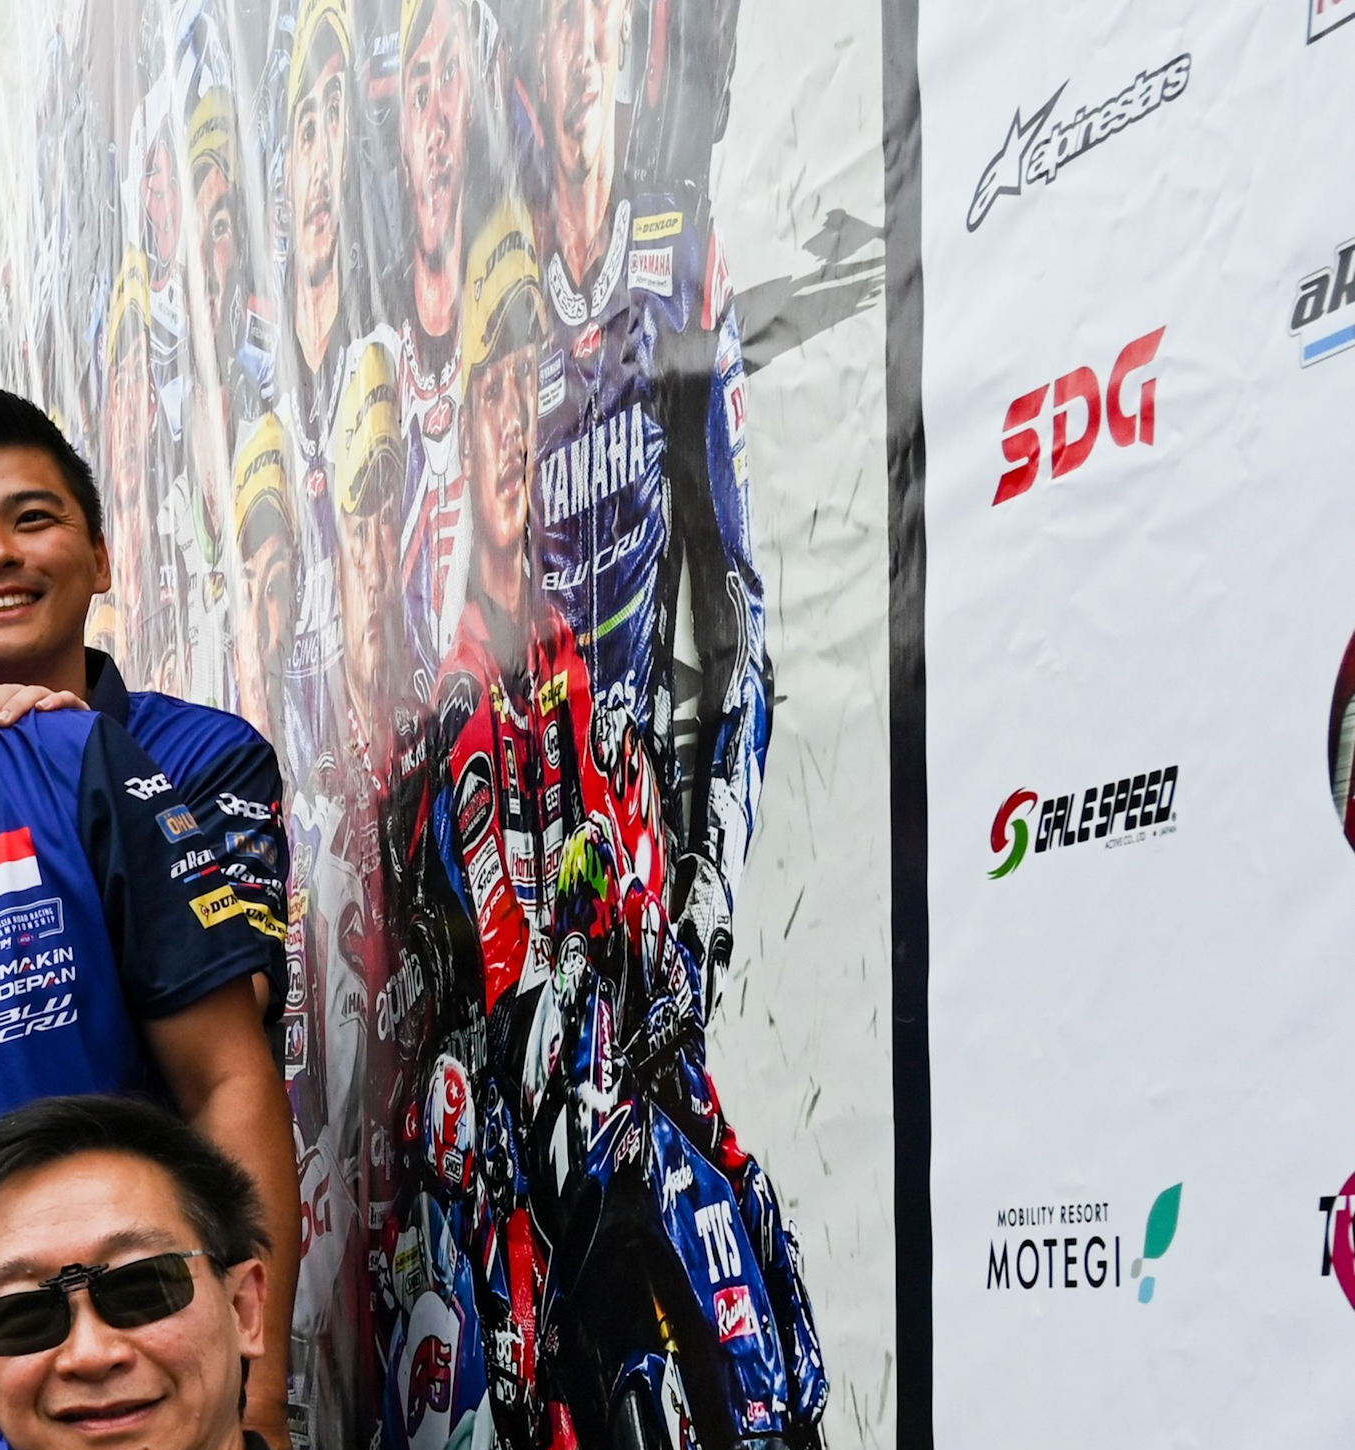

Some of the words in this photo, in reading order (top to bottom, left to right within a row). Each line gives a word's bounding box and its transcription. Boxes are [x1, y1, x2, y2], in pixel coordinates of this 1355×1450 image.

[639, 253, 671, 277] YAMAHA
[992, 325, 1166, 506] SDG
[541, 402, 646, 527] YAMAHA
[541, 561, 589, 590] BLU
[998, 1206, 1055, 1227] MOBILITY
[1060, 1203, 1109, 1224] RESORT
[694, 1200, 742, 1284] TVS
[987, 1236, 1120, 1289] MOTEGI
